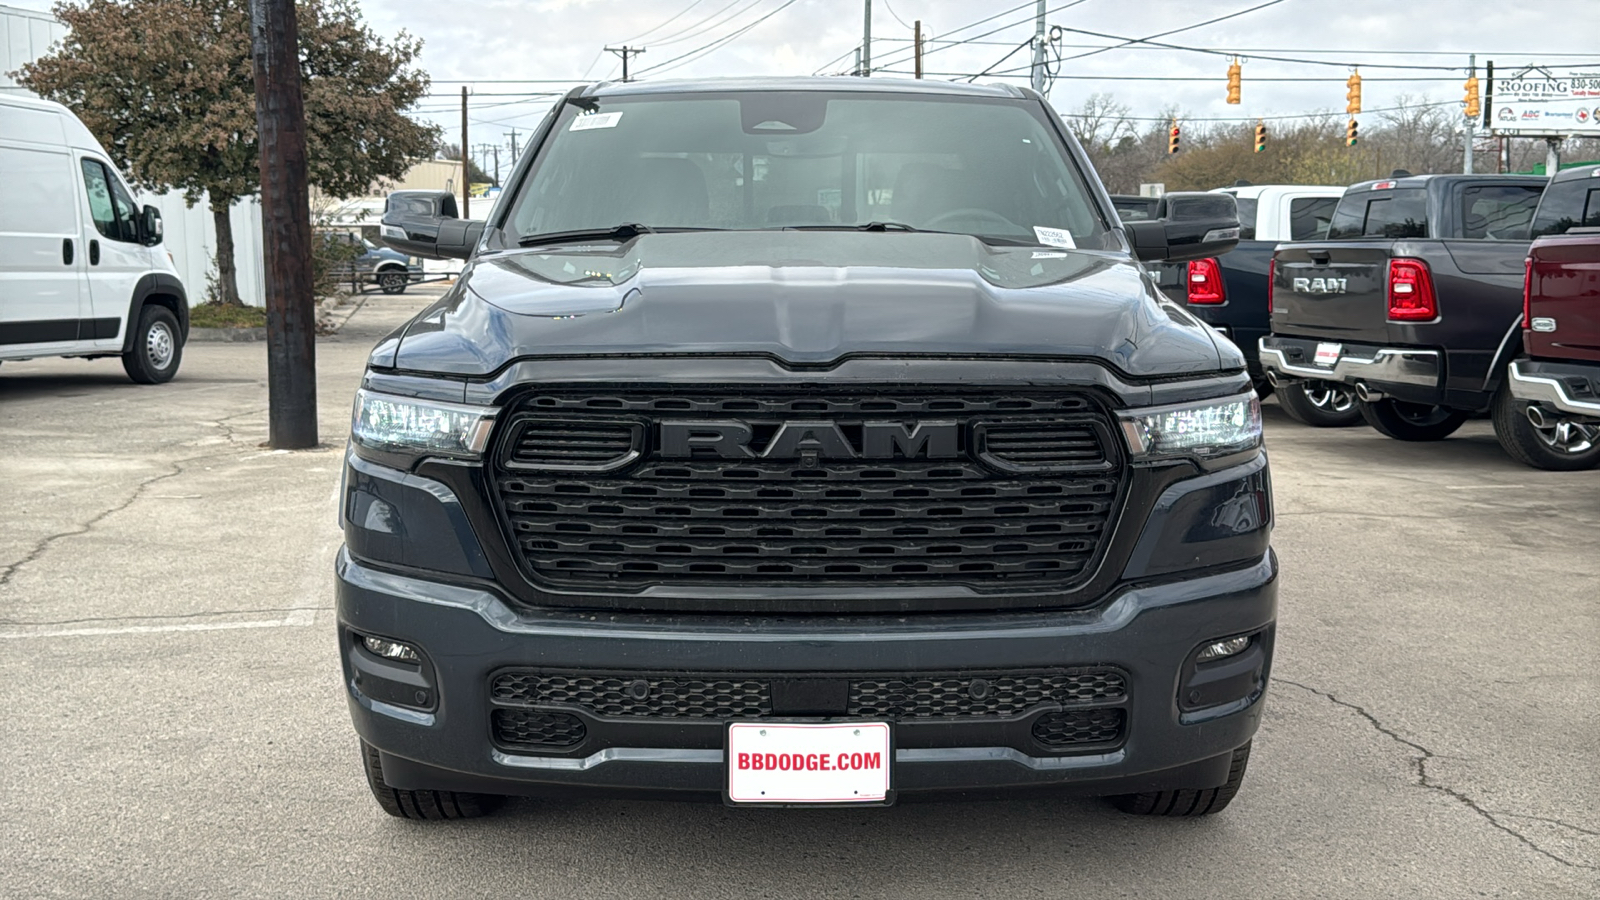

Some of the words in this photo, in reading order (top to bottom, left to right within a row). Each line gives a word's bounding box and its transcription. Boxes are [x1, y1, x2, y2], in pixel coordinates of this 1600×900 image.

[1499, 80, 1567, 93] ROOFING
[1521, 110, 1540, 118] ABC
[1293, 277, 1347, 294] RAM
[660, 419, 958, 459] RAM
[738, 752, 881, 771] BBDODGE.COM
